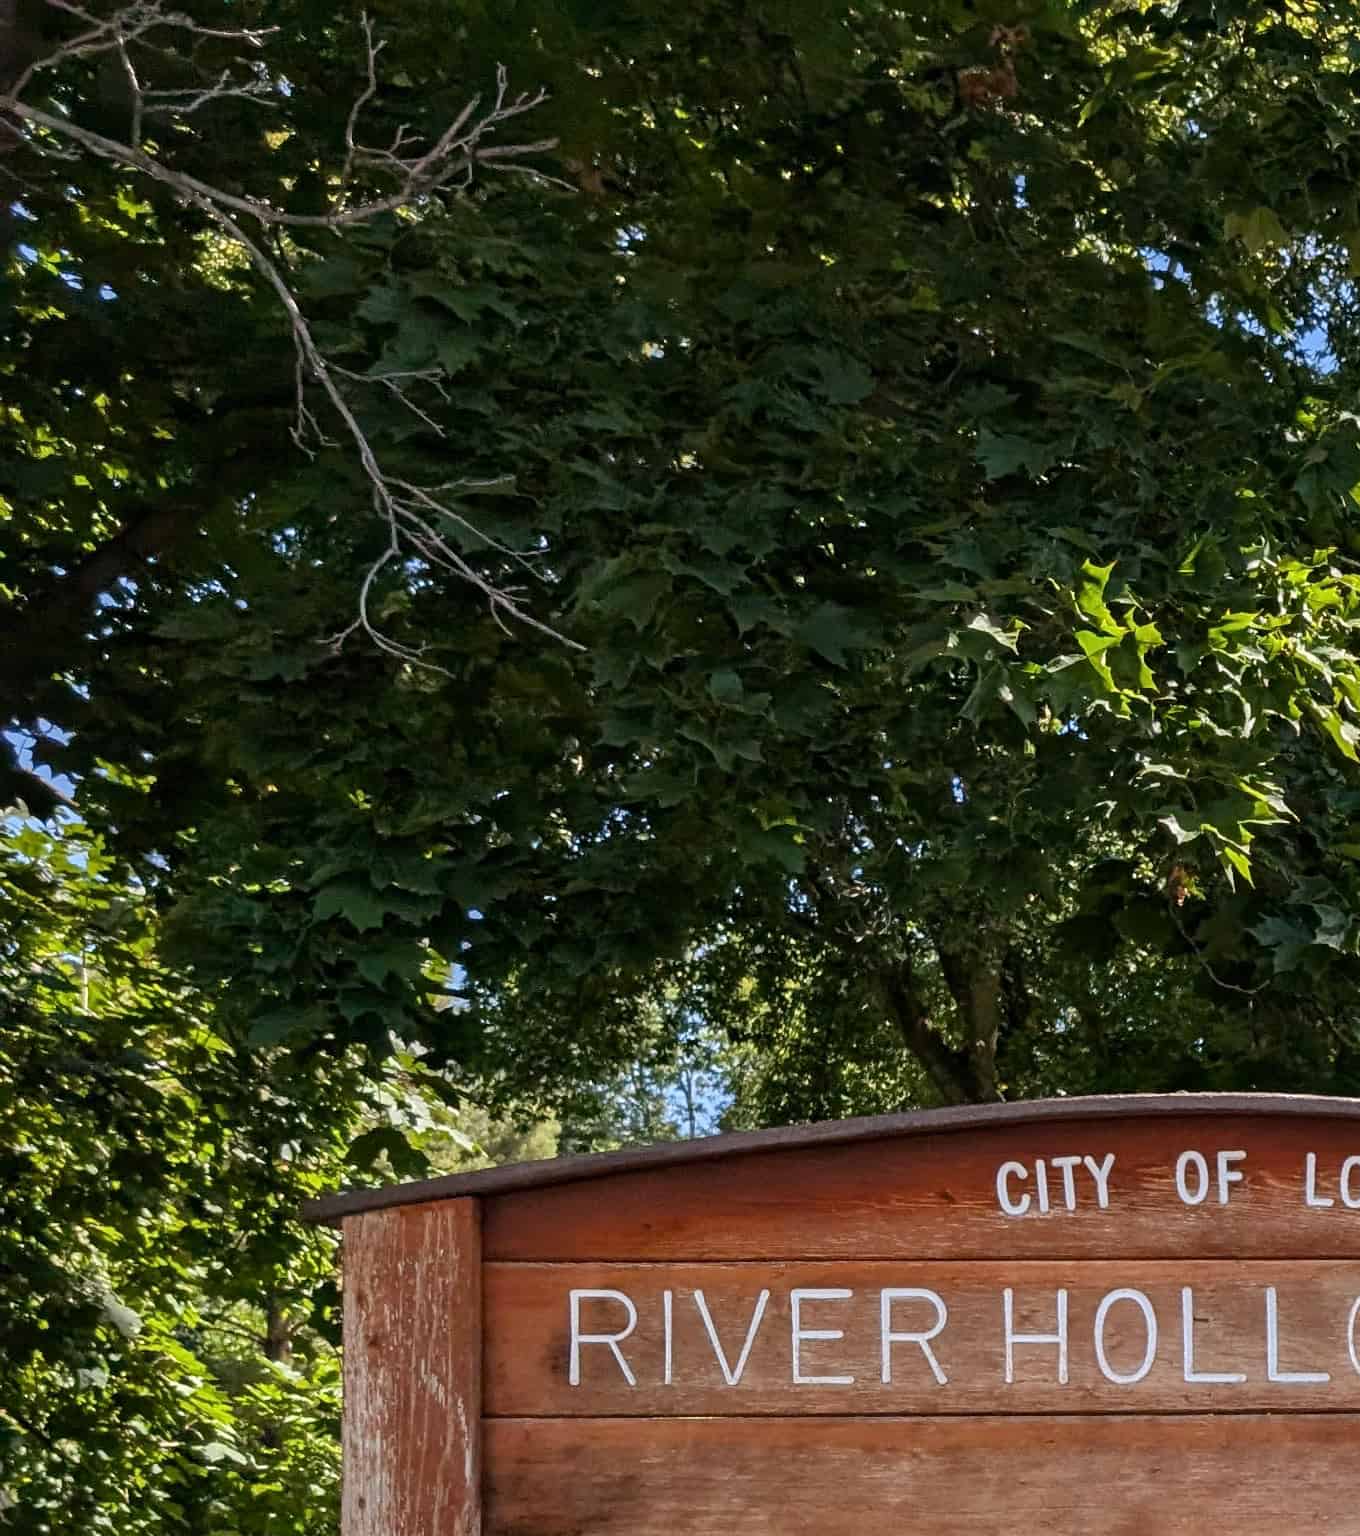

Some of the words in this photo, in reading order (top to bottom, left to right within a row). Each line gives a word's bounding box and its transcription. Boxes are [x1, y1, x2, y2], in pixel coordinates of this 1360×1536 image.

[996, 1154, 1115, 1217] CITY
[1174, 1150, 1247, 1207] OF
[568, 1288, 949, 1387] RIVER
